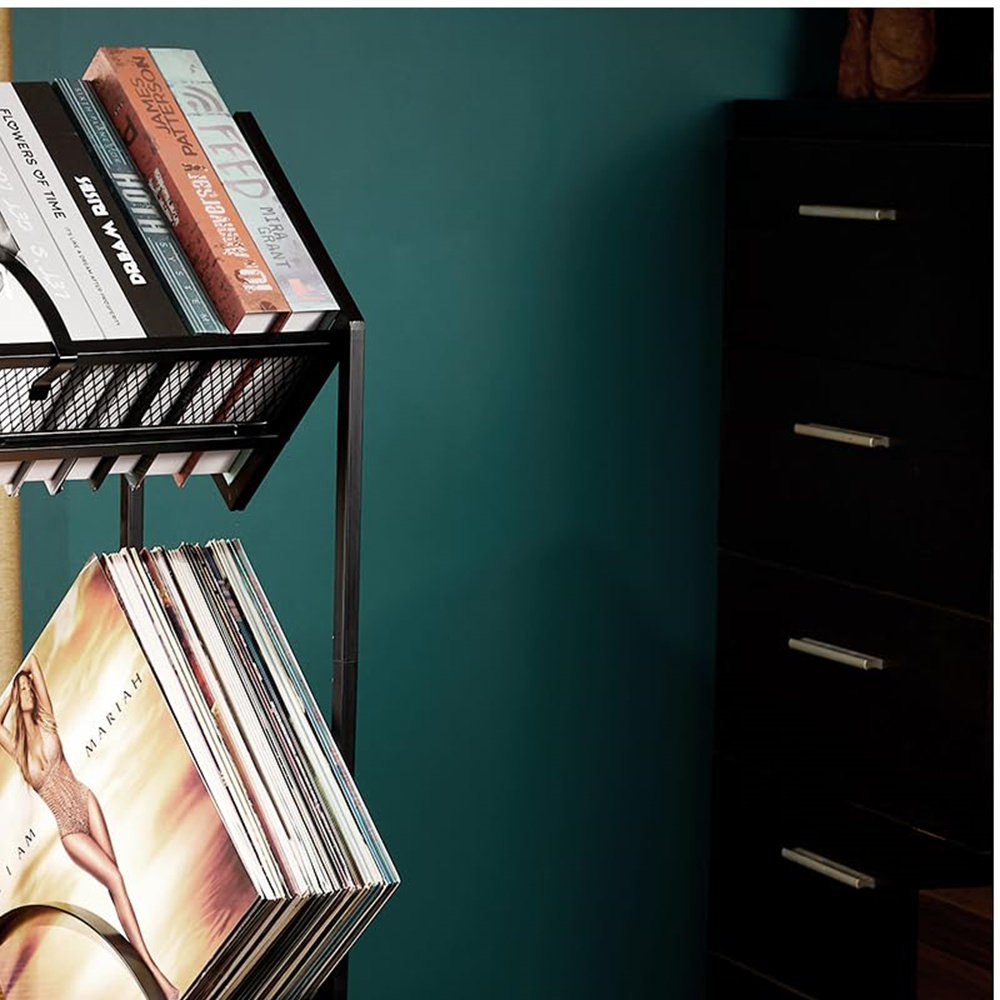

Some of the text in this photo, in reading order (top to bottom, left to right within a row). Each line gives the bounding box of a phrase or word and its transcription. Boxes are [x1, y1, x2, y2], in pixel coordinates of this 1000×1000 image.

[130, 76, 171, 135] JAMES
[131, 55, 198, 157] PATTERSON
[0, 107, 67, 220] FLOWERS OF TIME
[196, 123, 270, 199] FEED
[101, 219, 148, 287] DREAM
[257, 226, 292, 270] GRANT
[259, 205, 289, 240] MIRA
[159, 240, 211, 323] SYSTEM
[5, 865, 12, 876] I
[16, 827, 37, 860] AM
[84, 672, 143, 758] MARIAH
